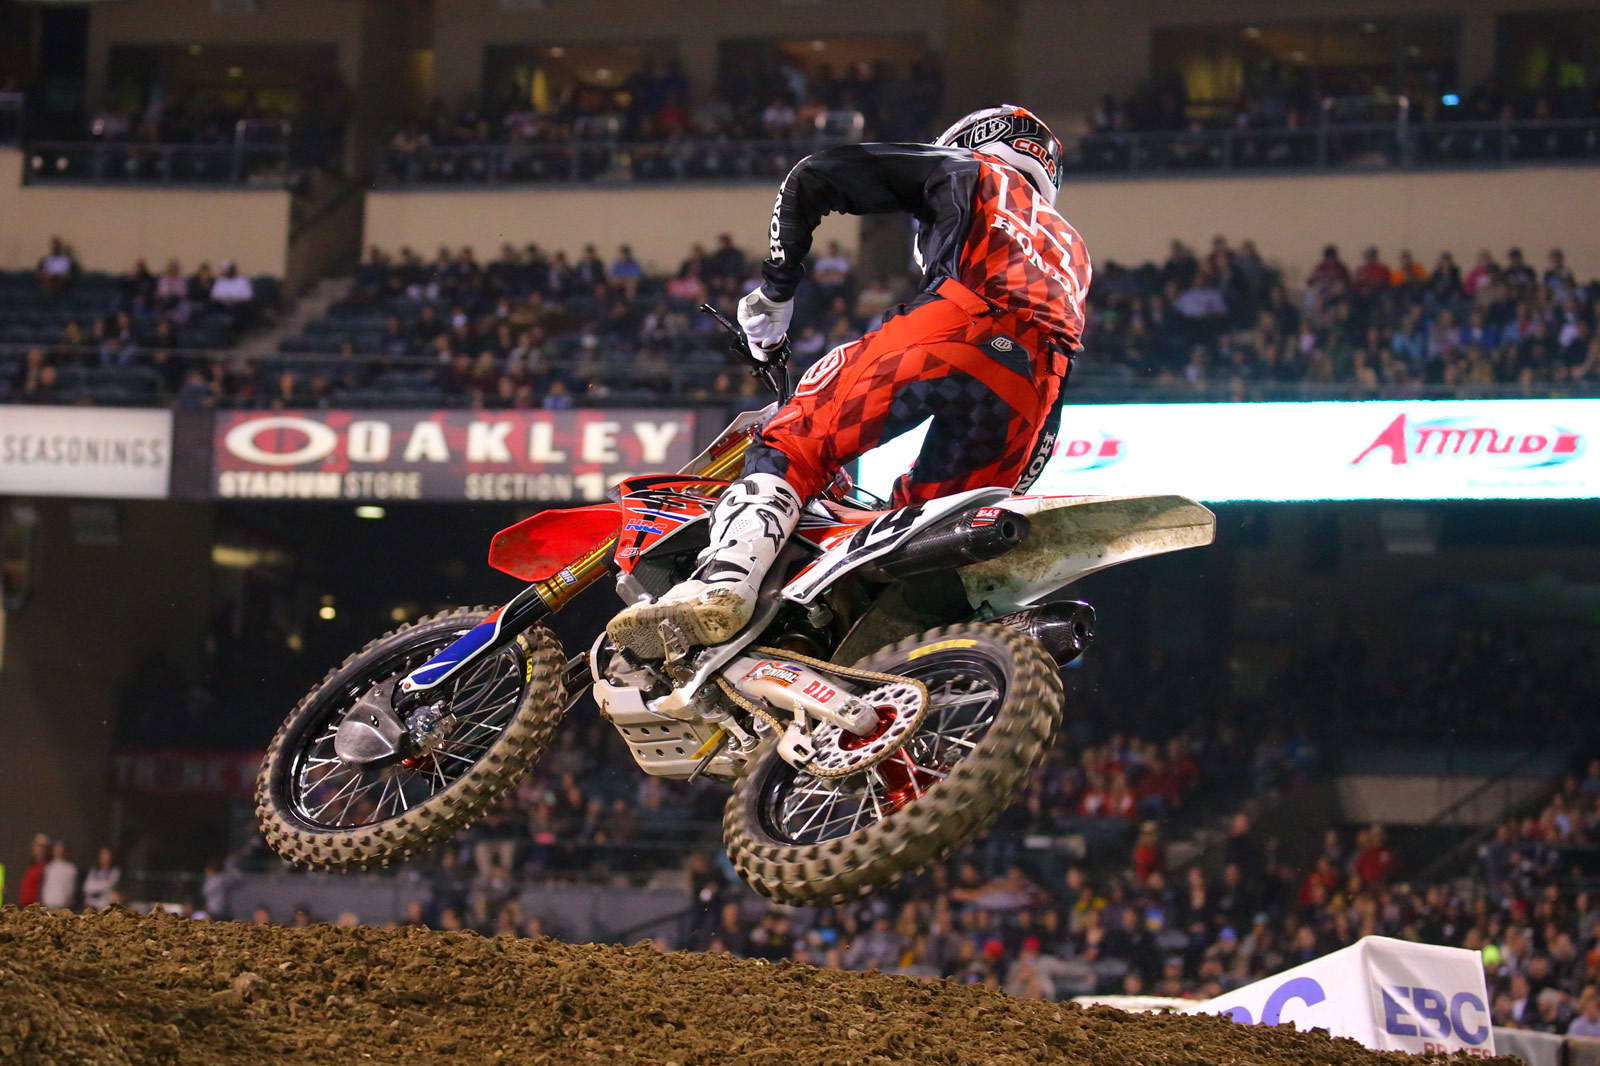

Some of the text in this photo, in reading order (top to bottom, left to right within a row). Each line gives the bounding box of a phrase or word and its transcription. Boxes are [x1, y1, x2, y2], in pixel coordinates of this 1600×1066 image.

[2, 433, 164, 469] SEASONINGS
[347, 420, 679, 463] OAKLEY
[218, 471, 341, 498] STADIUM
[344, 471, 422, 499] STORE
[465, 472, 573, 500] SECTION
[625, 518, 668, 536] HRC
[1381, 984, 1490, 1046] EBC
